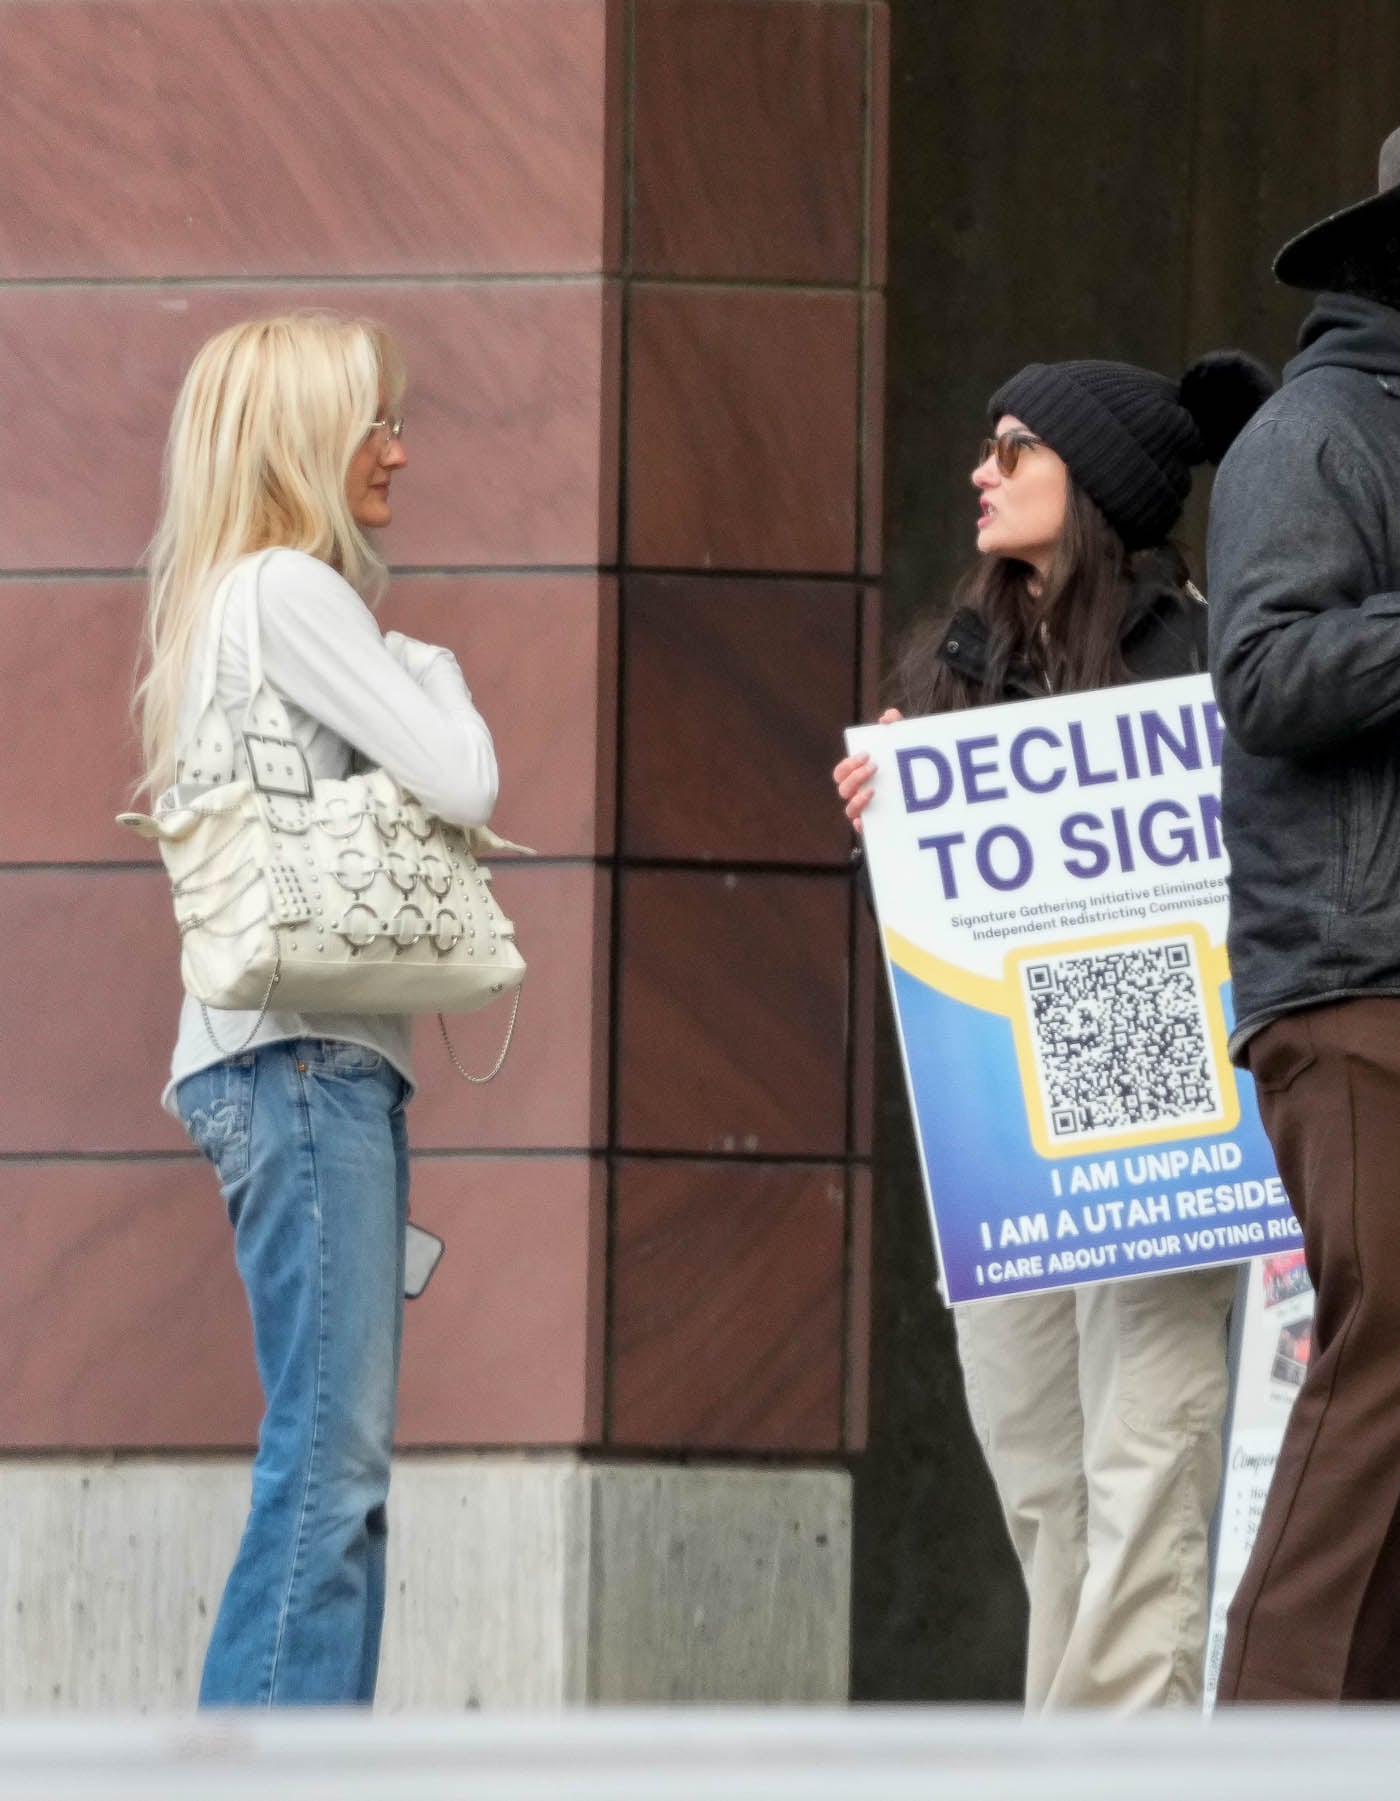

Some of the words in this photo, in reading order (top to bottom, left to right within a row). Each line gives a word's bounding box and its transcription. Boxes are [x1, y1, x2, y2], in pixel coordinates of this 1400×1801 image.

[918, 825, 1034, 900] TO
[951, 909, 1017, 928] Signature
[1019, 898, 1087, 917] Gathering
[1089, 887, 1151, 906] Initiative
[1153, 878, 1225, 897] Eliminates
[972, 919, 1057, 941] Independent
[1060, 903, 1146, 928] Redistricting
[1149, 893, 1229, 914] Commission
[1050, 1168, 1063, 1197] I
[1069, 1160, 1120, 1195] AM
[1124, 1142, 1243, 1185] UNPAID
[980, 1221, 993, 1250] I
[999, 1213, 1050, 1248] AM
[1056, 1209, 1079, 1239] A
[1083, 1194, 1172, 1234] UTAH
[1175, 1176, 1290, 1220] RESIDE
[975, 1264, 985, 1286] I
[987, 1255, 1044, 1284] CARE
[1048, 1243, 1118, 1274] ABOUT
[1121, 1234, 1182, 1261] YOUR
[1184, 1221, 1265, 1251] VOTING
